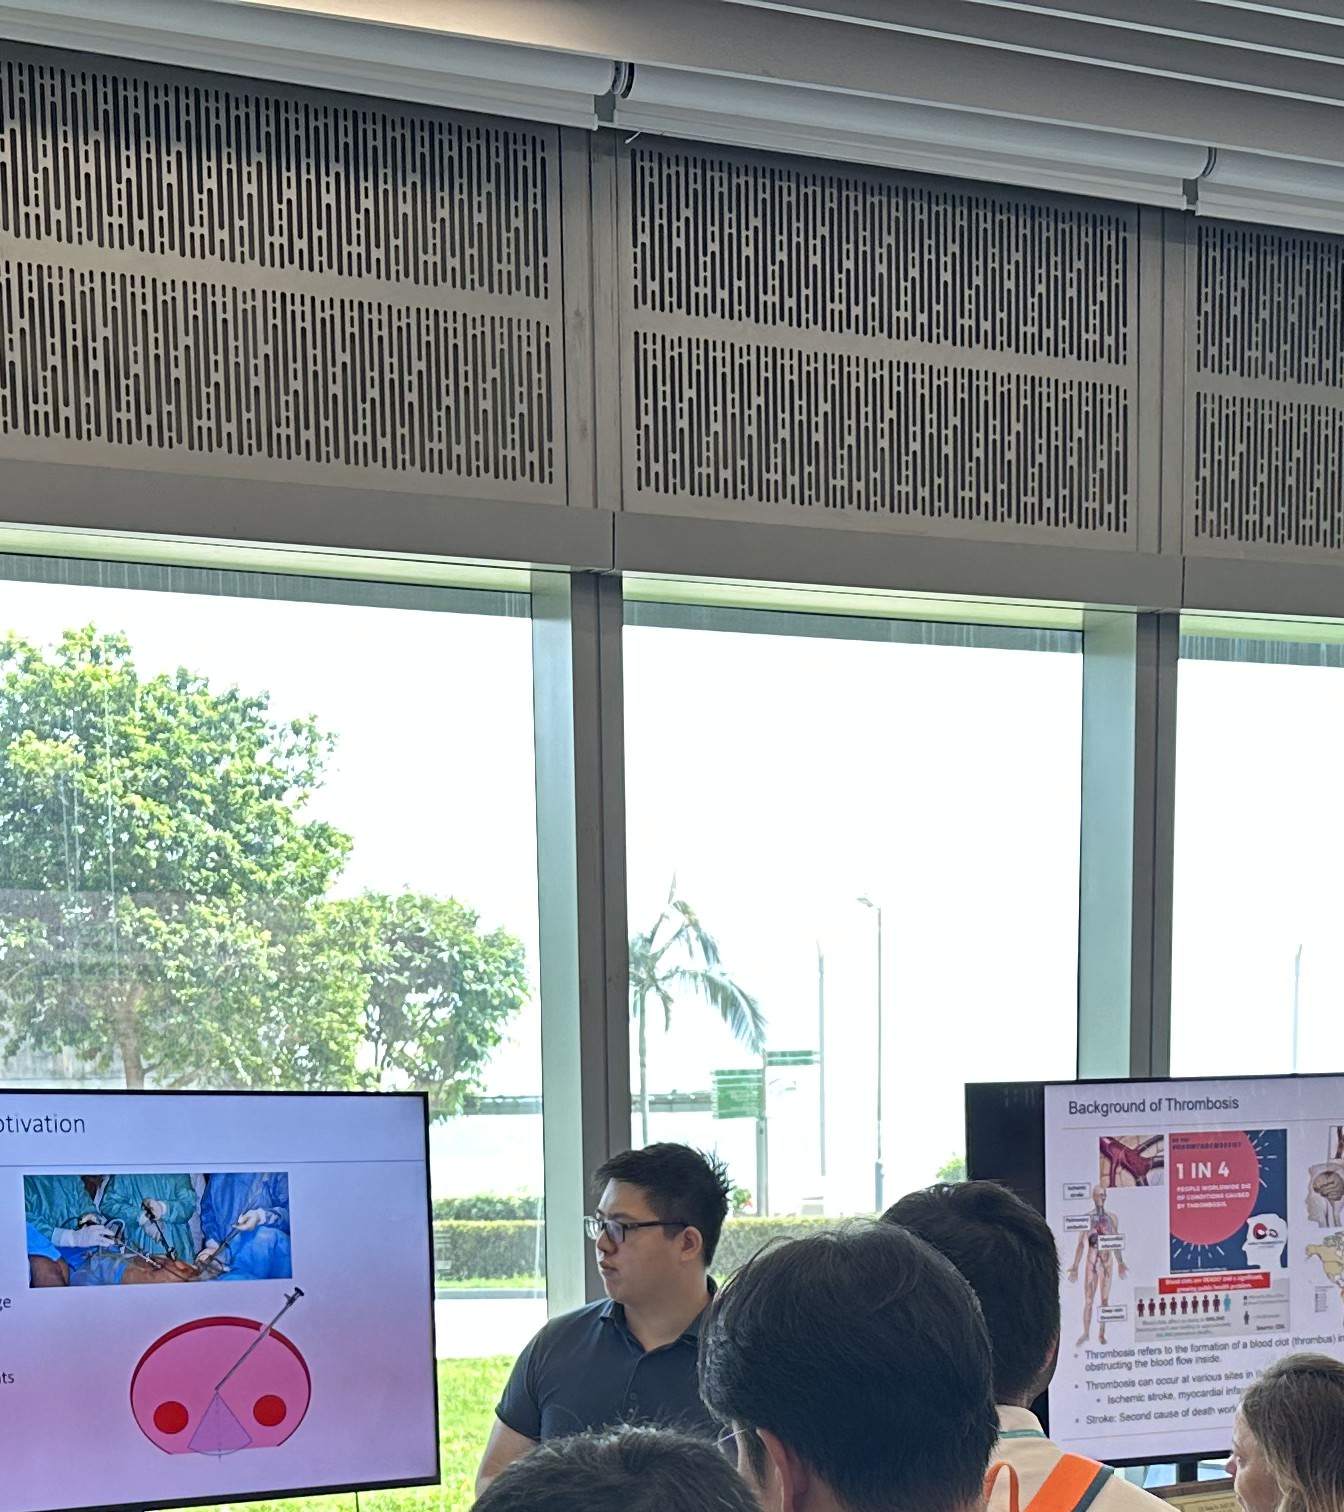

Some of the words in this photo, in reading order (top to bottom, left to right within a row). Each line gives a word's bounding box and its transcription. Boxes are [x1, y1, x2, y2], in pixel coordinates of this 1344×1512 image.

[1068, 1098, 1146, 1117] Background
[1150, 1098, 1163, 1112] of
[1165, 1096, 1239, 1112] Thrombosis
[1176, 1163, 1184, 1179] 1
[1191, 1162, 1212, 1179] IN
[1218, 1161, 1230, 1177] 4
[1085, 1350, 1135, 1360] Thrombosis
[1137, 1347, 1162, 1356] refers
[1164, 1346, 1173, 1355] to
[1175, 1345, 1189, 1354] the
[1191, 1342, 1229, 1353] formation
[1232, 1341, 1240, 1350] of
[1250, 1337, 1272, 1348] blood
[1275, 1337, 1289, 1347] clot
[1292, 1334, 1336, 1346] (thrombus)
[1085, 1361, 1132, 1372] obstructing
[1135, 1358, 1148, 1368] the
[1150, 1357, 1174, 1367] blood
[1175, 1356, 1193, 1365] flow
[1086, 1380, 1135, 1390] Thrombosis
[1138, 1379, 1153, 1387] can
[1156, 1377, 1179, 1385] occur
[1181, 1375, 1190, 1383] at
[1191, 1374, 1222, 1383] various
[1224, 1371, 1244, 1380] sites
[1246, 1370, 1254, 1379] in
[1107, 1393, 1145, 1404] Ischemic
[1178, 1388, 1224, 1400] myocardial
[1086, 1414, 1117, 1424] Stroke:
[1120, 1411, 1152, 1421] Second
[1154, 1410, 1179, 1419] cause
[1181, 1407, 1189, 1416] of
[1192, 1406, 1215, 1416] death
